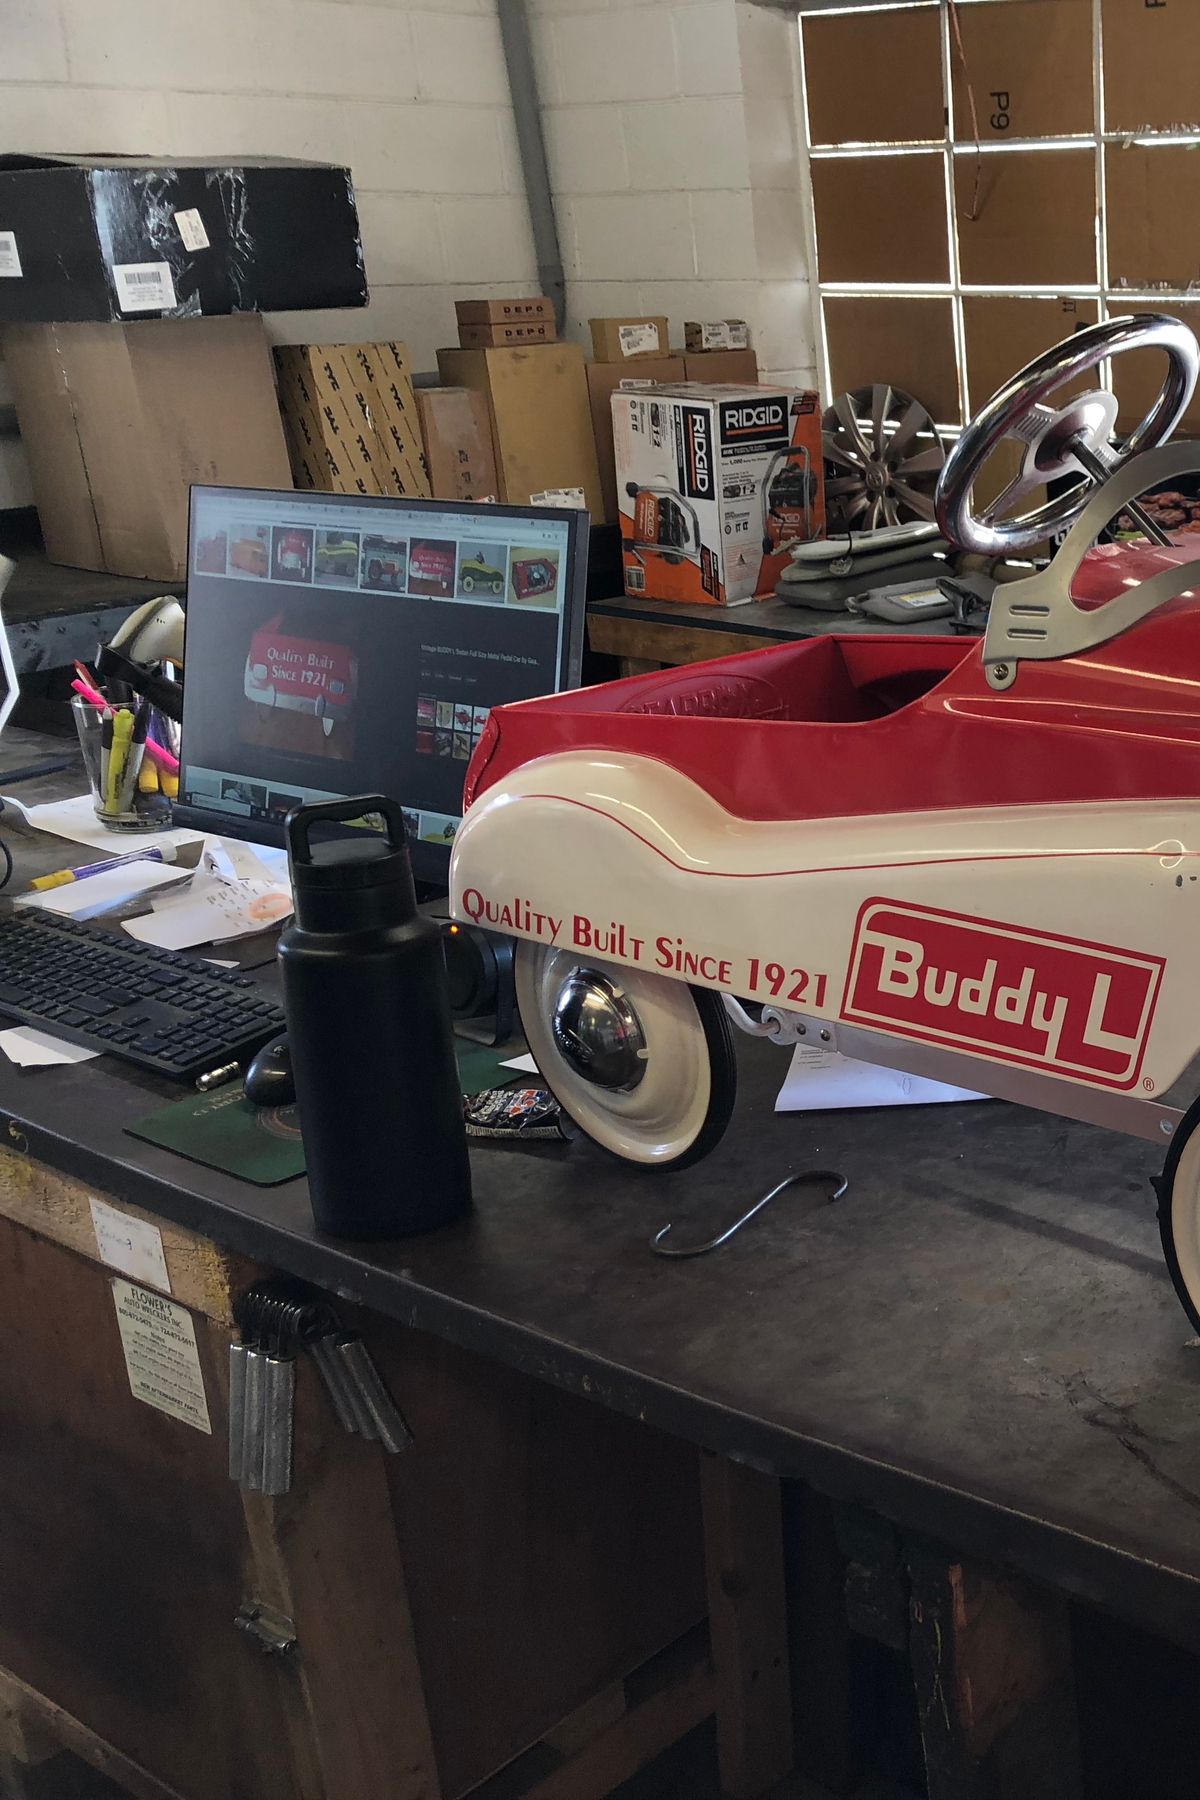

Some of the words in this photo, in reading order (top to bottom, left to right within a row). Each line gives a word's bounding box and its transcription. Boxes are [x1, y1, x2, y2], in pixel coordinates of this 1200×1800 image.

[503, 305, 544, 314] DEPO
[505, 327, 545, 337] DEPO
[324, 362, 340, 392] TYC
[390, 383, 405, 412] TYC
[323, 406, 340, 435] TYC
[725, 405, 783, 429] RIDGID
[356, 434, 372, 463] TYC
[389, 425, 404, 453] TYC
[692, 414, 709, 492] RIDGID
[325, 448, 340, 476] TYC
[391, 467, 405, 494] TYC
[647, 499, 655, 537] RIDGID
[300, 670, 327, 687] 1921
[462, 888, 562, 945] Quality
[573, 915, 645, 961] Built
[655, 936, 732, 984] Since
[747, 958, 828, 1008] 1921
[866, 930, 1068, 1059] Buddy
[1083, 973, 1136, 1055] L
[131, 1288, 173, 1316] FLOWER'S
